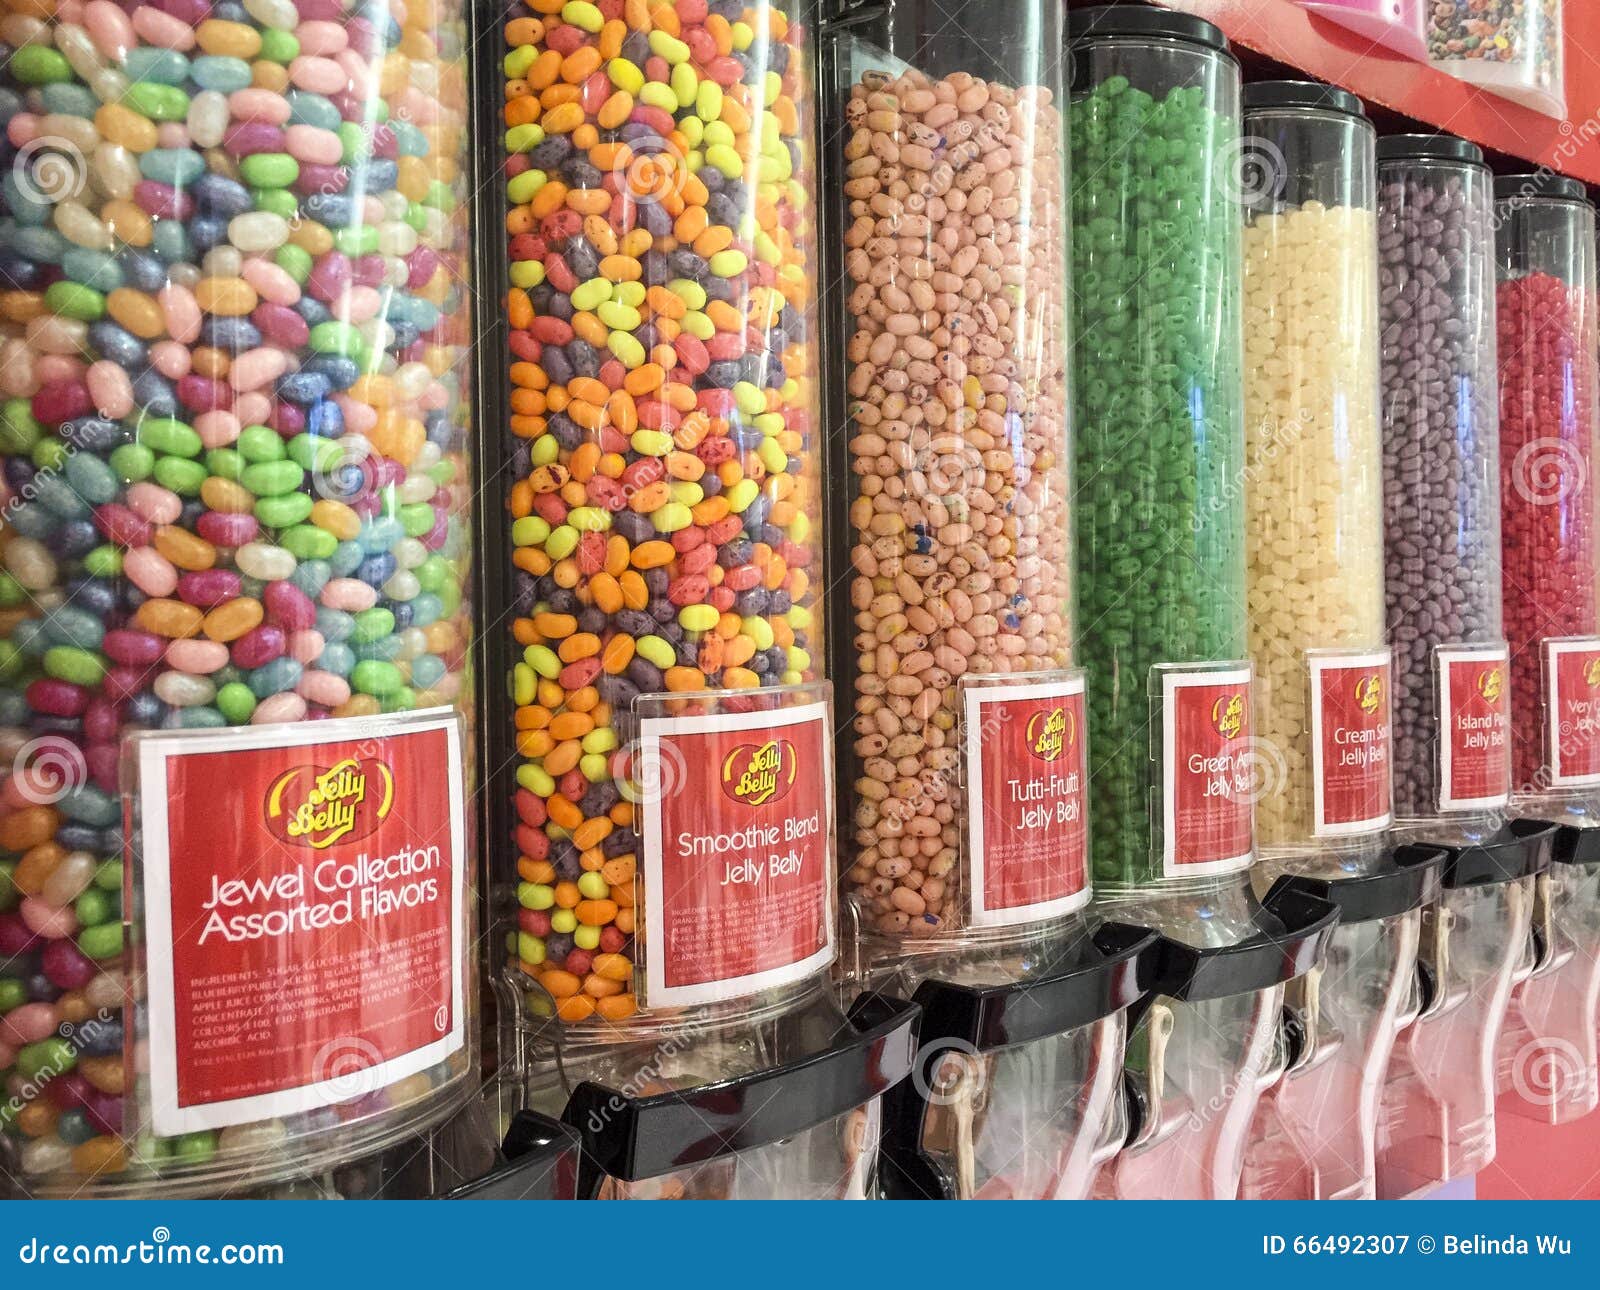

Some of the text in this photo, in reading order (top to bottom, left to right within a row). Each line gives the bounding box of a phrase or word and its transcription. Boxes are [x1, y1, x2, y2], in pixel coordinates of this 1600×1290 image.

[1044, 707, 1065, 735] Jelly
[1458, 713, 1492, 730] Island
[1567, 699, 1592, 718] Very
[1035, 733, 1062, 760] Belly
[1334, 727, 1376, 744] Cream
[1464, 731, 1489, 751] Jelly
[748, 740, 782, 773] Jelly
[1188, 753, 1234, 774] Green
[1339, 746, 1368, 768] Jelly
[308, 759, 366, 806] Jelly
[734, 771, 776, 805] Belly
[1203, 775, 1232, 799] Jelly
[287, 799, 356, 849] Belly
[1016, 796, 1081, 832] Jelly Belly
[678, 809, 820, 857] Smoothie Blend
[202, 843, 441, 911] Jewel Collection
[720, 849, 804, 887] Jelly Belly
[197, 876, 439, 946] Assorted Flavors
